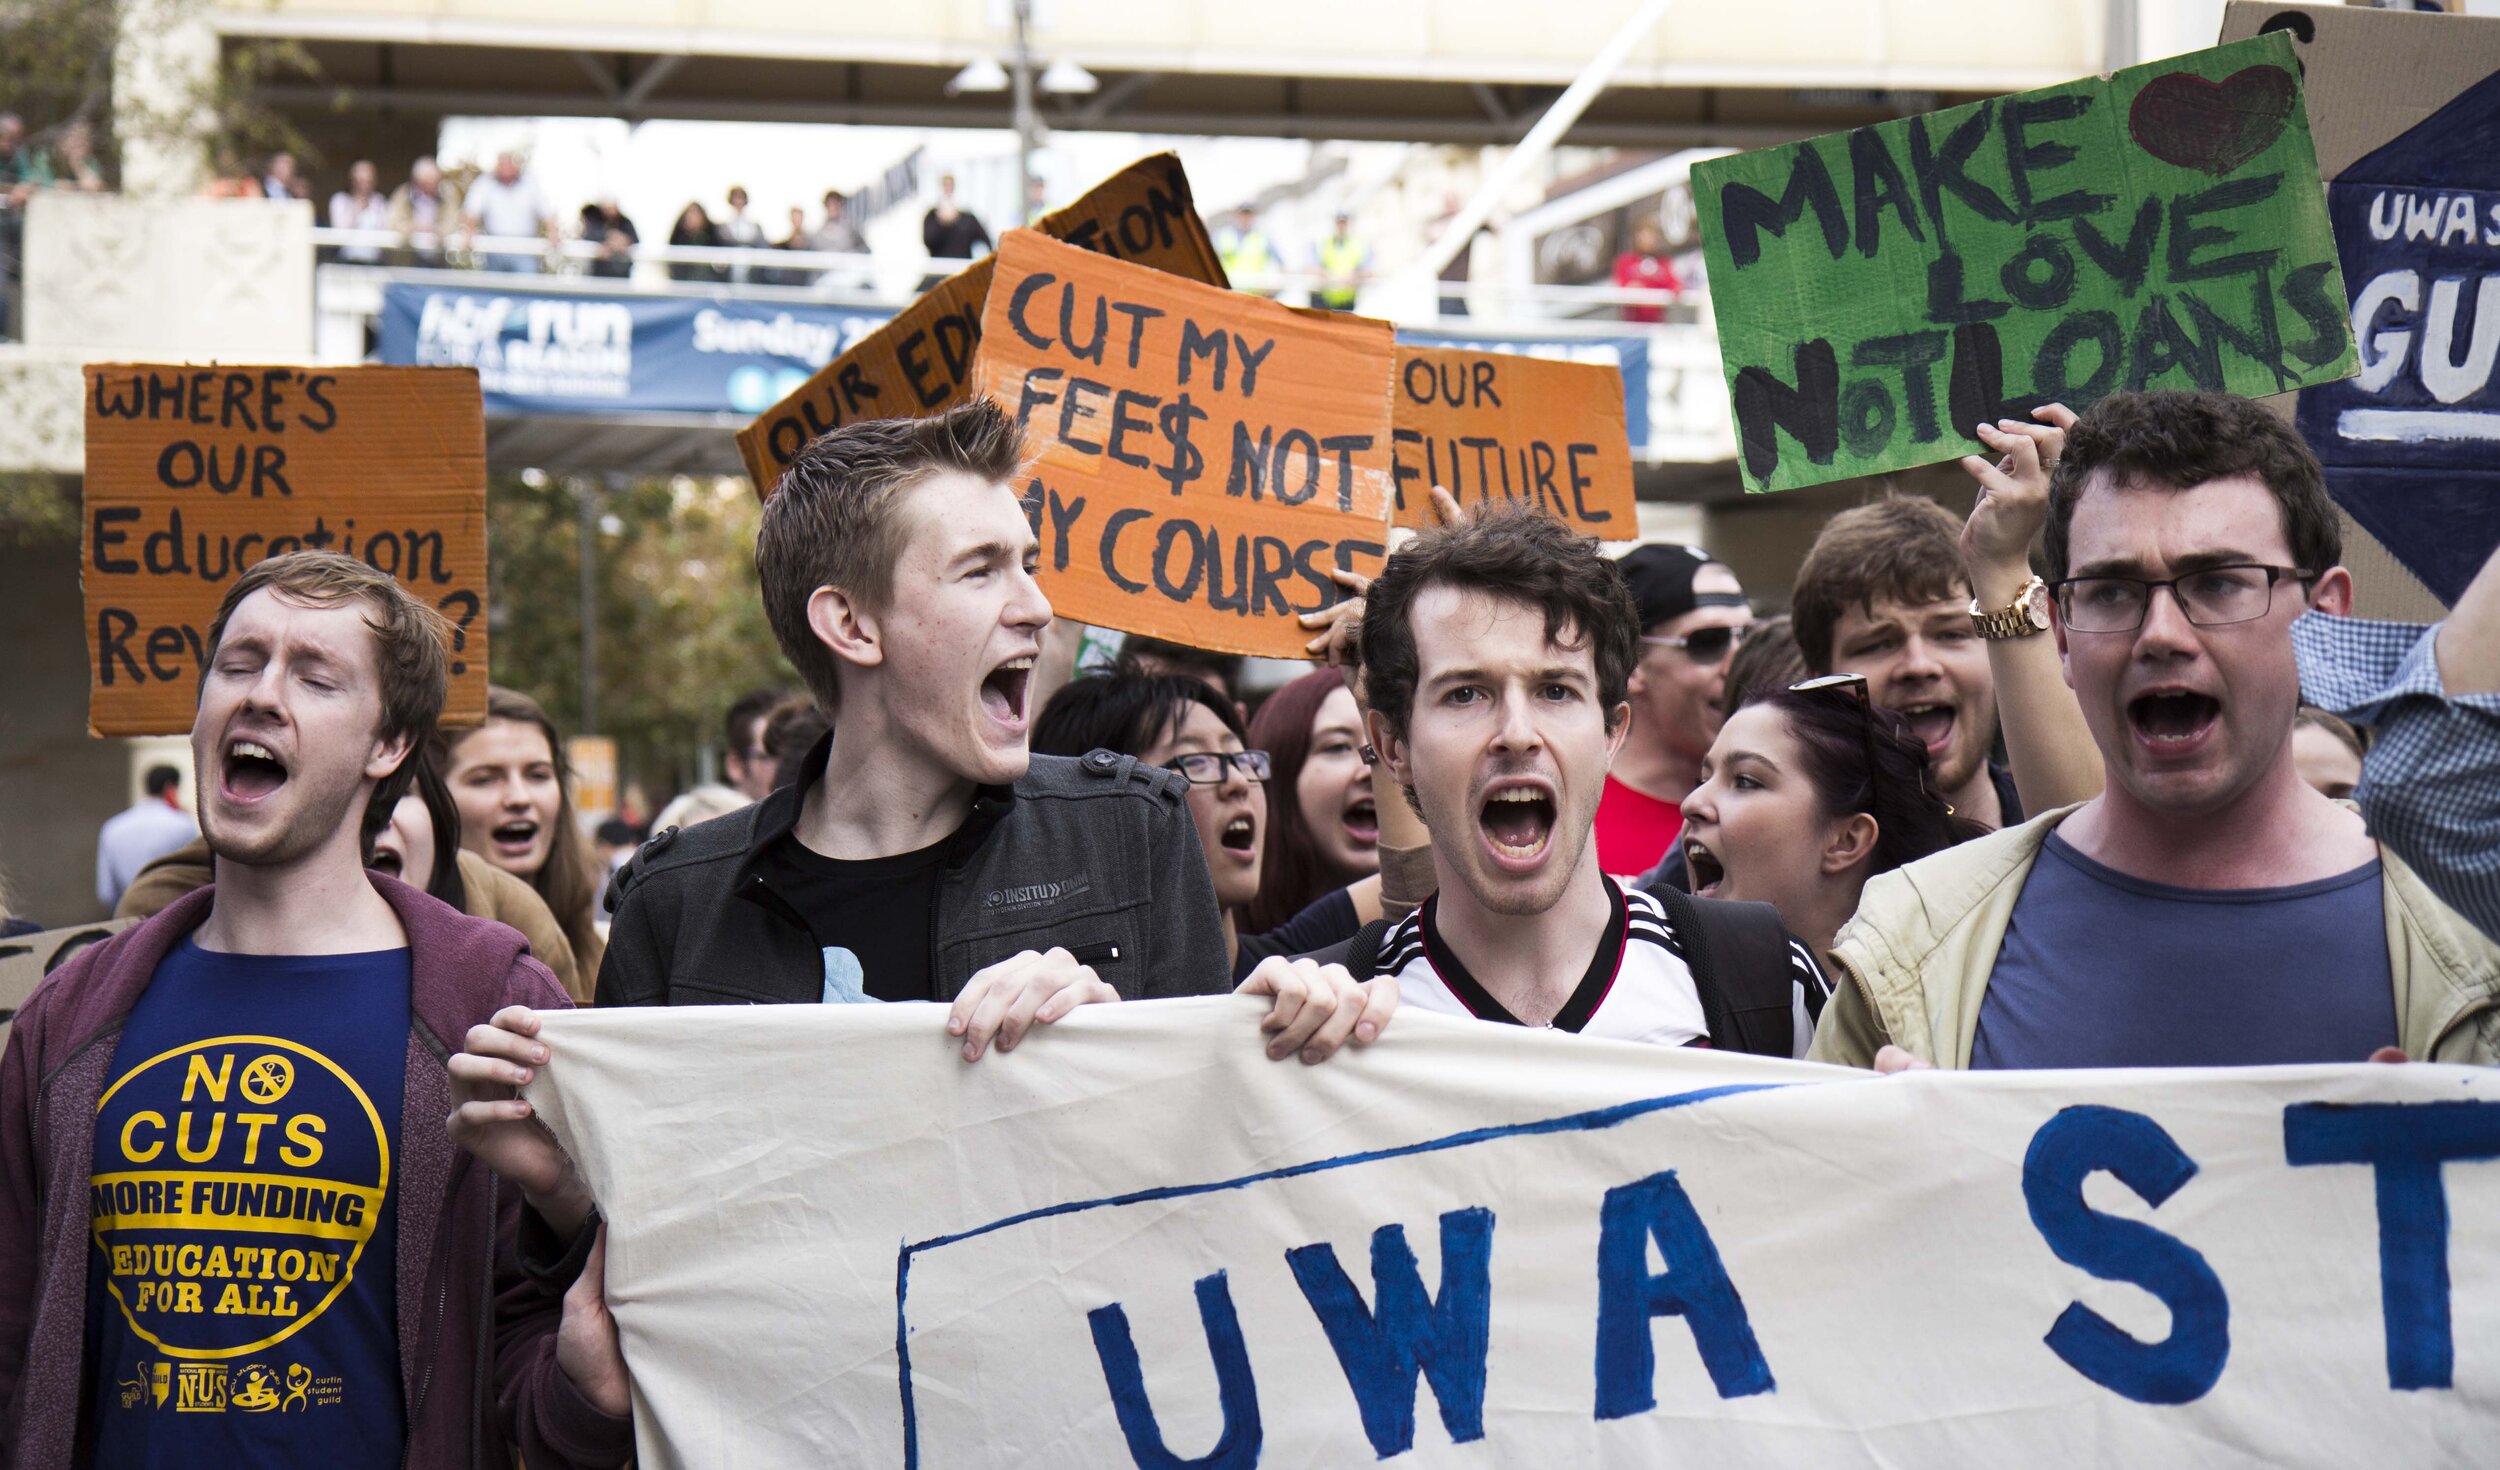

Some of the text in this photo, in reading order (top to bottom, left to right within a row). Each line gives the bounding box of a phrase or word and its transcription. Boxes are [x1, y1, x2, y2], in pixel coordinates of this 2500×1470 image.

[1721, 95, 2117, 270] MAKE
[1927, 172, 2288, 323] LOVE
[693, 308, 840, 367] Sunday
[1008, 272, 1275, 397] CUT MY
[95, 370, 338, 433] WHERE'S
[1404, 358, 1502, 408] OUR
[1734, 262, 2350, 490] NOT LOANS
[769, 362, 879, 465] OUR
[1016, 367, 1375, 512] FEE$ NOT
[157, 440, 292, 498] OUR
[1392, 428, 1612, 523] FUTURE
[180, 1054, 295, 1105] NO
[120, 1110, 327, 1168] CUTS
[90, 1180, 366, 1228] MORE FUNDING
[112, 1243, 341, 1283] EDUCATION
[1087, 1098, 2500, 1470] UWA ST
[136, 1281, 299, 1317] FOR ALL
[307, 1386, 342, 1395] student
[315, 1376, 342, 1384] curtin
[317, 1396, 341, 1406] guild
